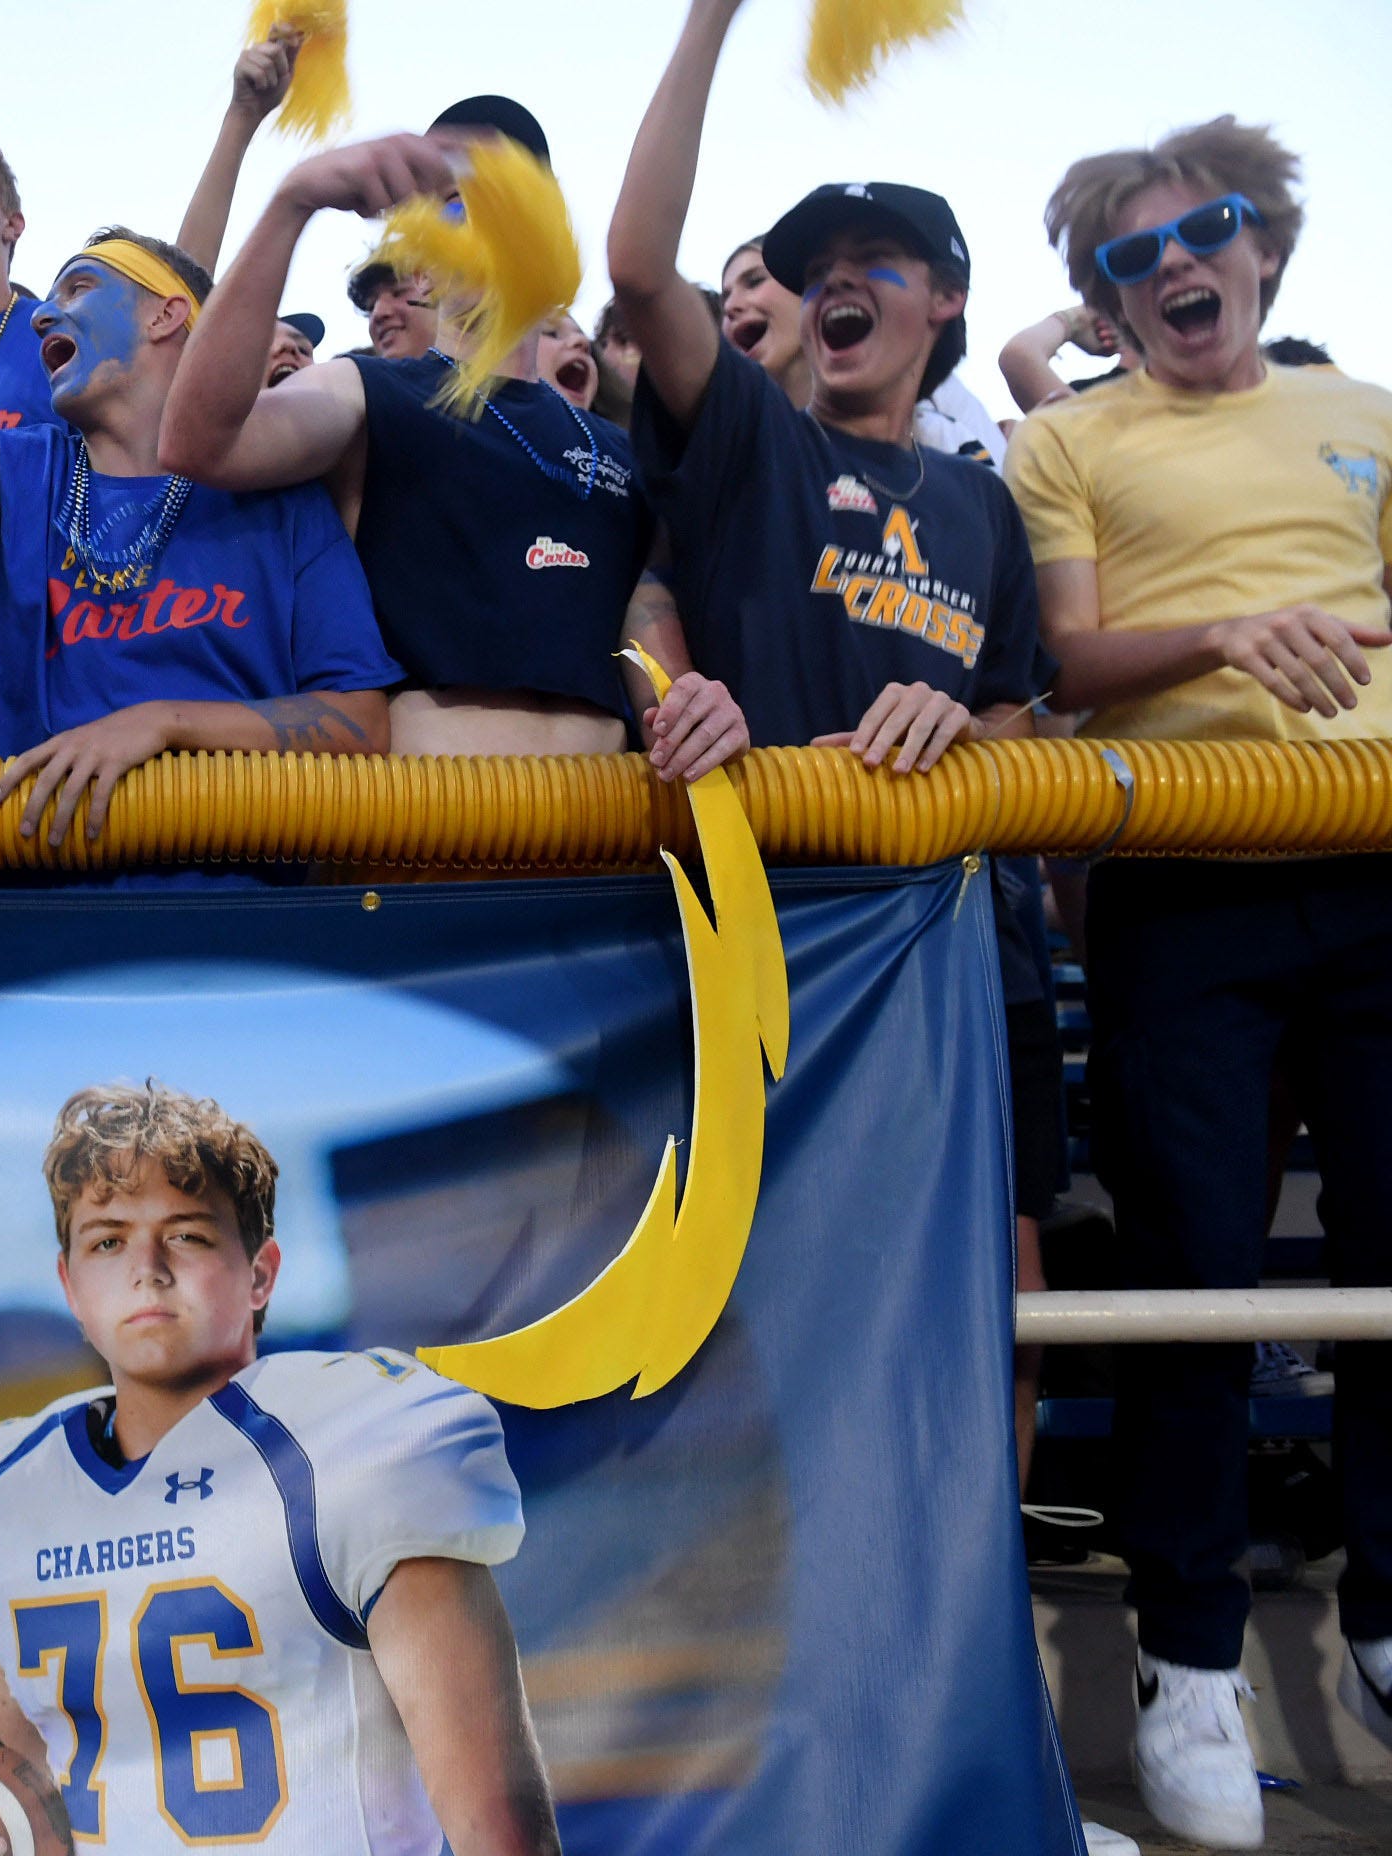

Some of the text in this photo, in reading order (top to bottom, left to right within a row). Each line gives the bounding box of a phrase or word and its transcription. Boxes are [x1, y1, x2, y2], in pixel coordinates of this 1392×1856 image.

[528, 547, 587, 566] Carter
[36, 1526, 196, 1581] CHARGERS
[9, 1575, 290, 1847] 76
